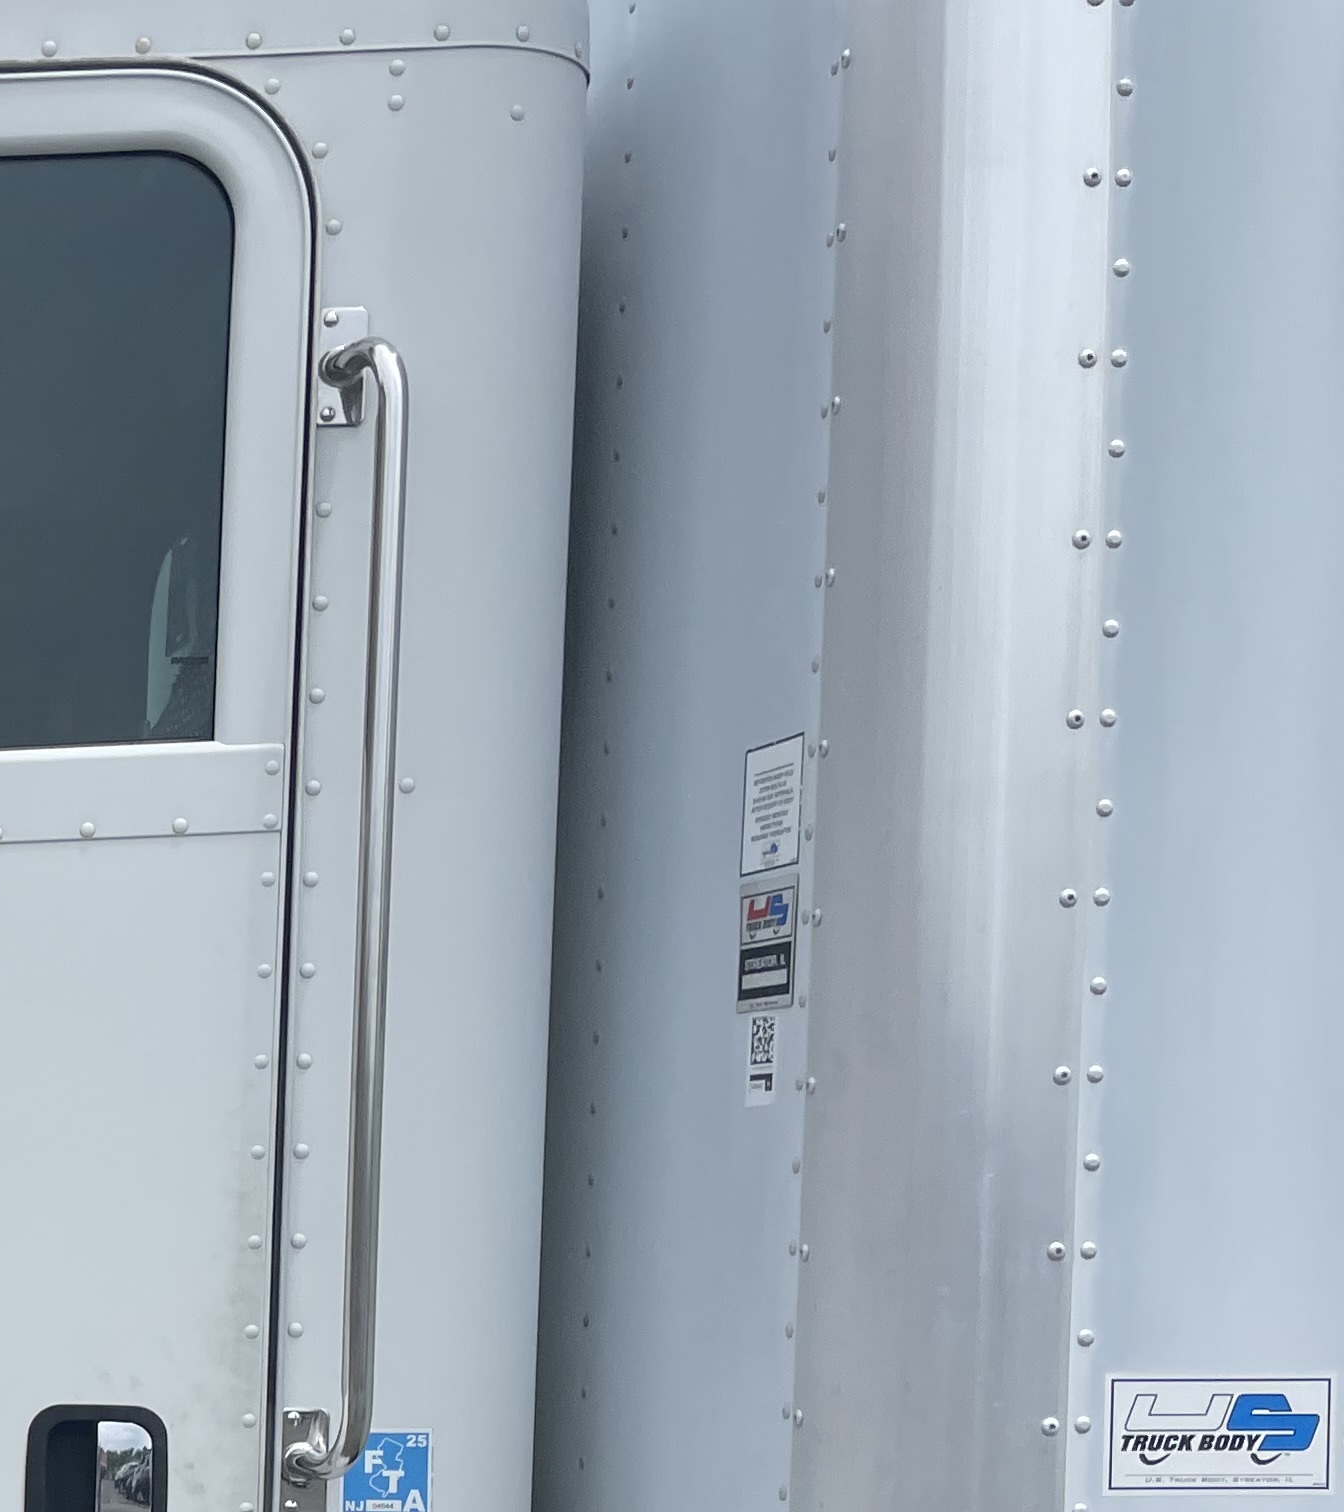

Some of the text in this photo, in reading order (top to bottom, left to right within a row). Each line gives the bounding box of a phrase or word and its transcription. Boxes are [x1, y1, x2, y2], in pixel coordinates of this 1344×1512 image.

[406, 1434, 428, 1448] 25
[1120, 1434, 1262, 1452] TRUCK BODY
[345, 1500, 365, 1512] NJ
